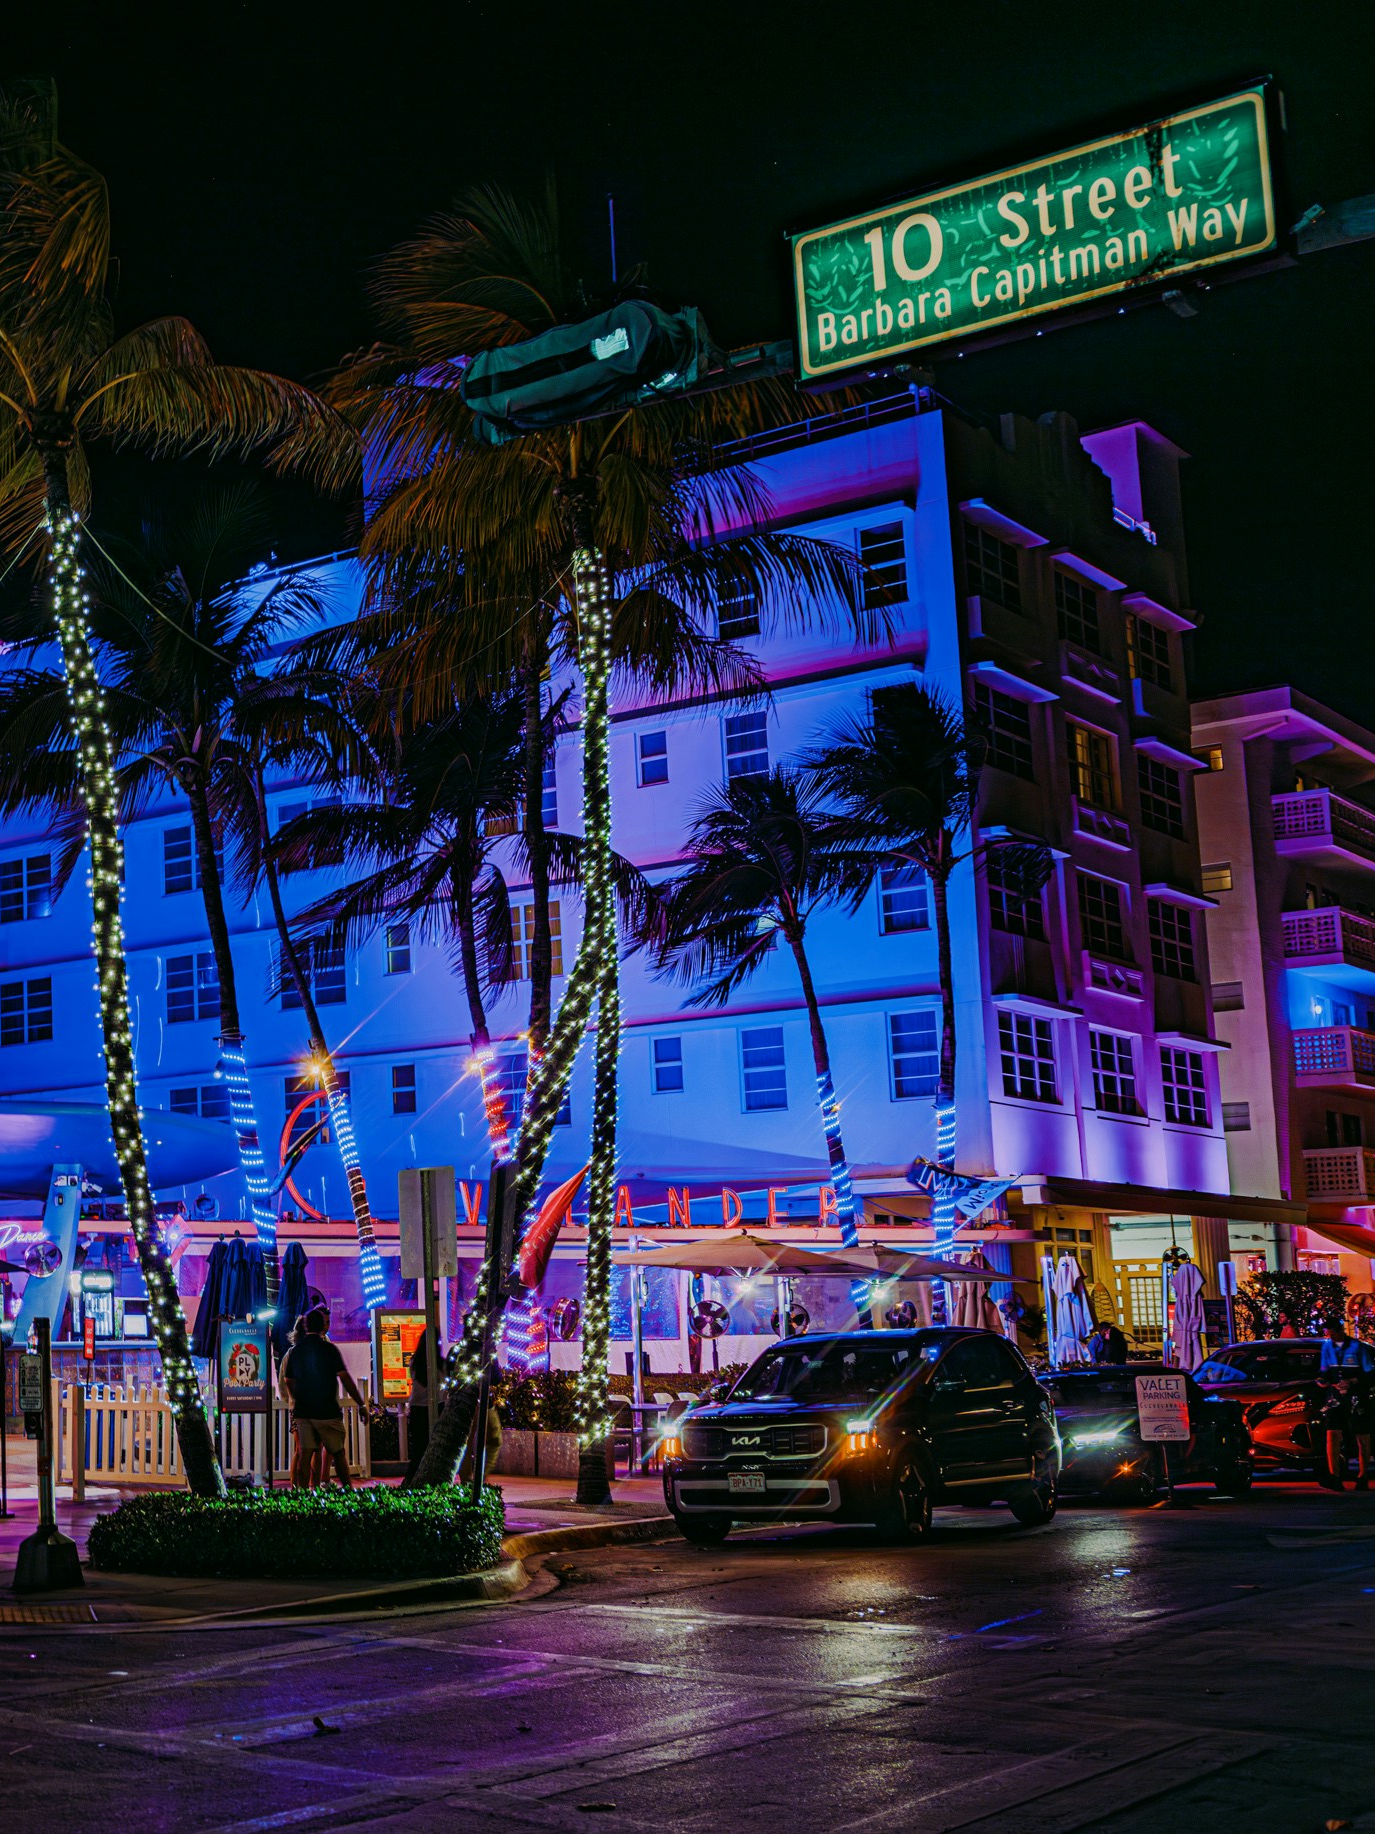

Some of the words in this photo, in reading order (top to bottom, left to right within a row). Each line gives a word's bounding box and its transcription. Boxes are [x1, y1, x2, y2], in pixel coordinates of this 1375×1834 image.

[865, 212, 944, 292] 10
[997, 146, 1183, 248] Street
[818, 284, 952, 352] Barbara
[971, 228, 1148, 306] Capitman
[1167, 198, 1250, 251] Way
[223, 1378, 242, 1388] Pool
[243, 1378, 265, 1390] Party
[1138, 1378, 1181, 1390] VALET
[1143, 1391, 1181, 1400] PARKING
[731, 1436, 761, 1446] KIA
